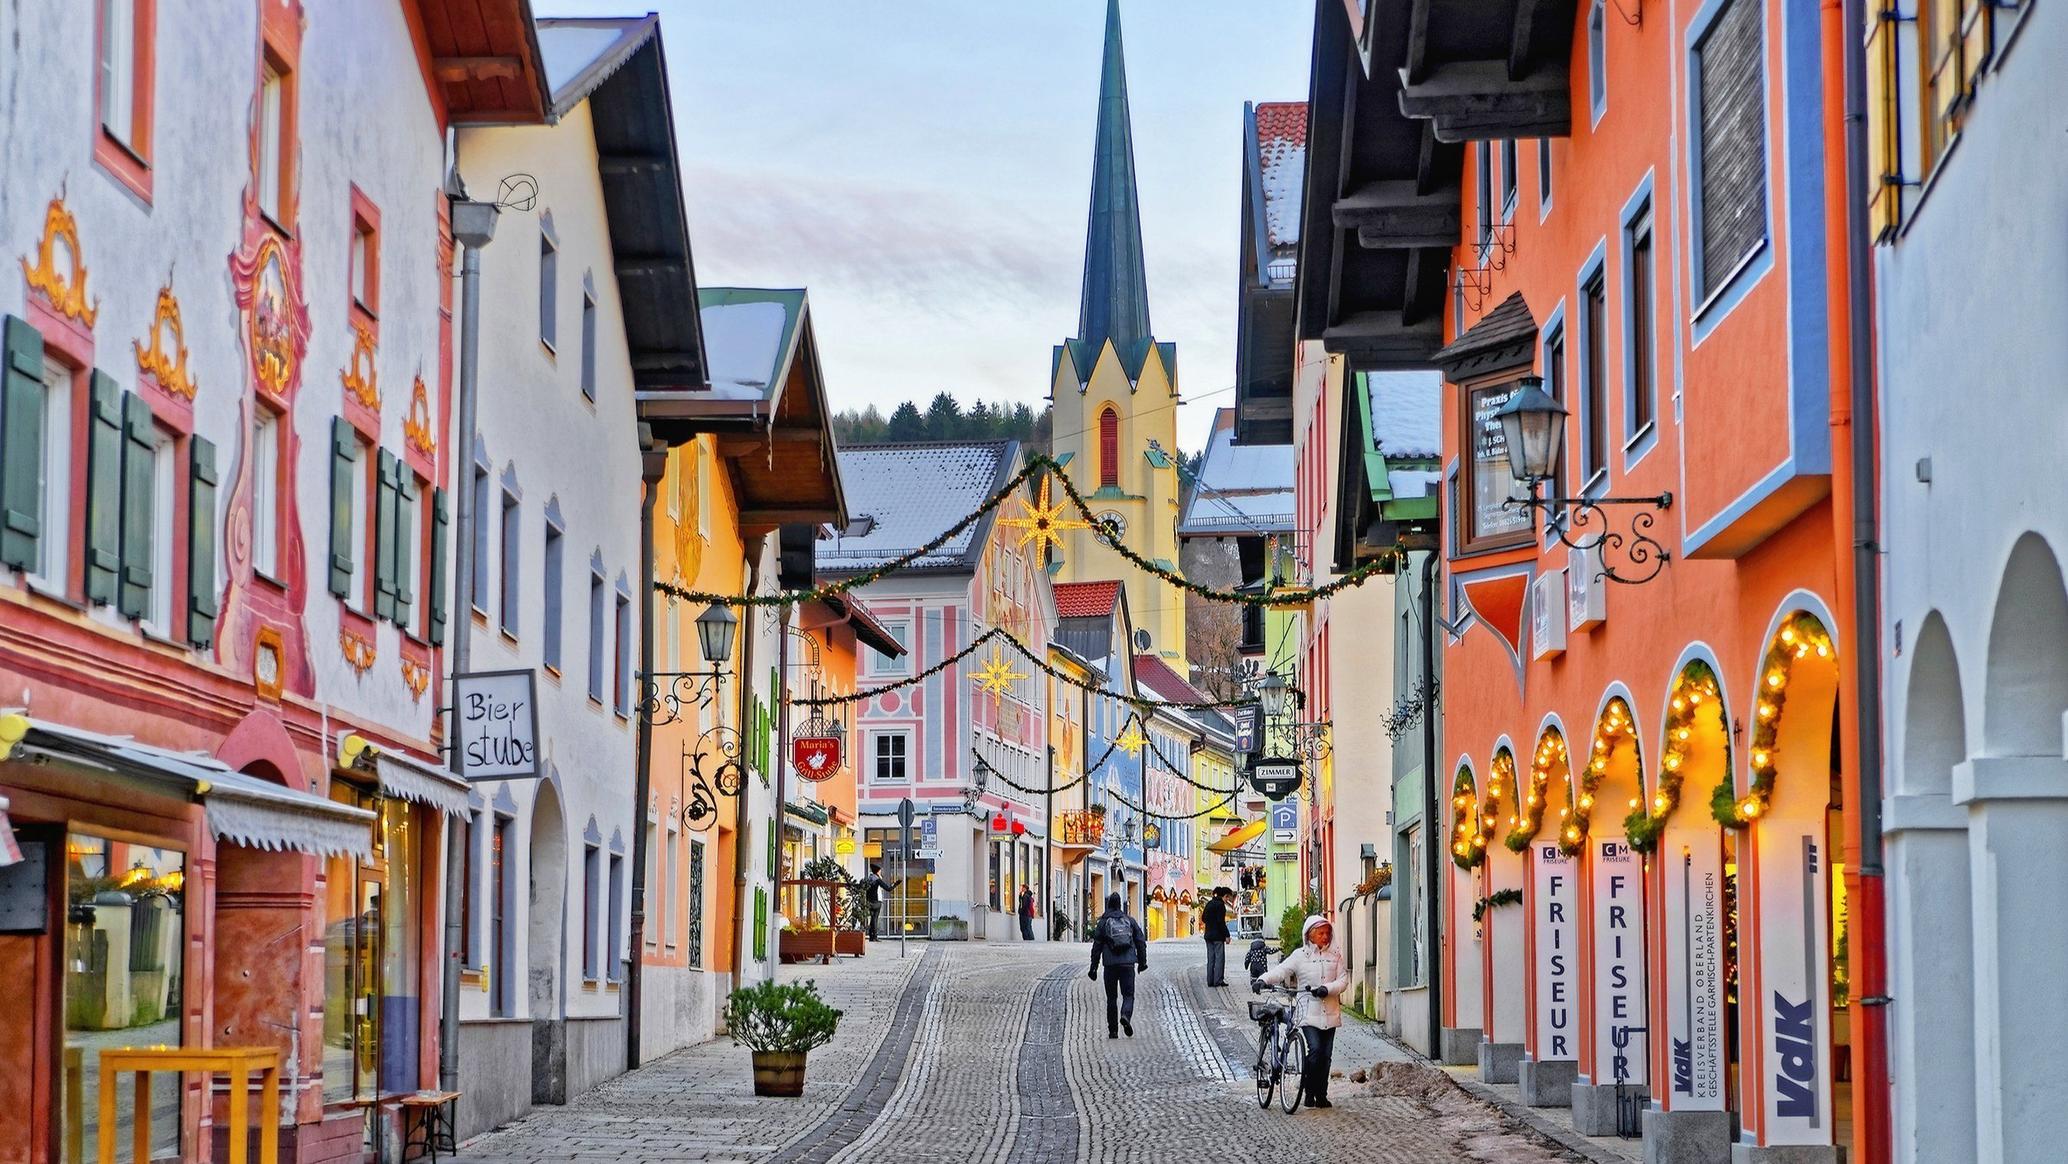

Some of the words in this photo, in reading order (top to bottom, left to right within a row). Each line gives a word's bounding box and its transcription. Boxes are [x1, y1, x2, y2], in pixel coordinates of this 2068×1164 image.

[1481, 393, 1508, 408] Praxis
[1485, 420, 1502, 432] The
[1493, 435, 1505, 445] SCH
[466, 693, 524, 721] Bier
[467, 720, 533, 767] stube
[800, 740, 834, 749] Maria's
[925, 821, 933, 834] P
[1281, 812, 1291, 827] P
[1695, 914, 1704, 988] OBERLAND
[1705, 872, 1716, 1009] GARMISCH-PARTENKIRCHEN
[1550, 876, 1568, 1056] FRISEUR
[1609, 876, 1630, 1079] FRISEUR
[1673, 1037, 1691, 1092] VdK
[1696, 995, 1706, 1098] KREISVERBAND
[1774, 989, 1815, 1117] VdK
